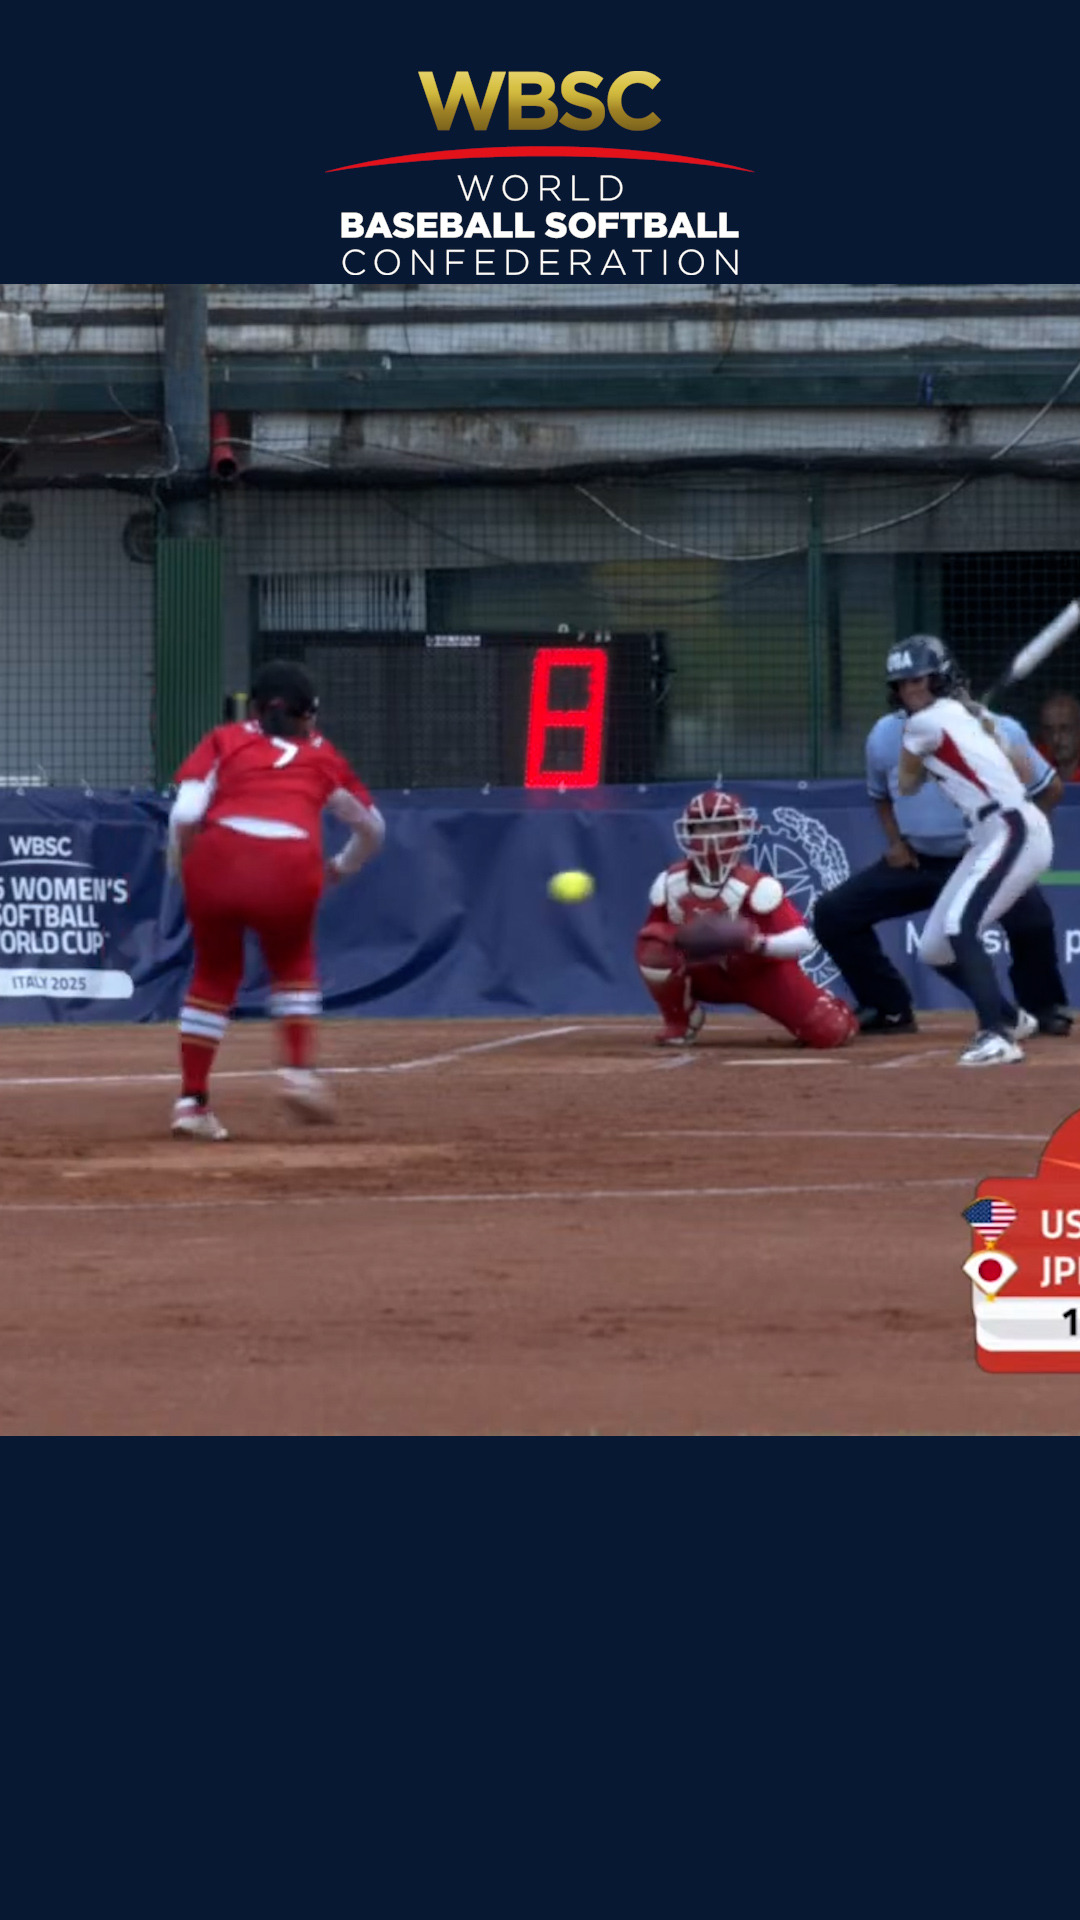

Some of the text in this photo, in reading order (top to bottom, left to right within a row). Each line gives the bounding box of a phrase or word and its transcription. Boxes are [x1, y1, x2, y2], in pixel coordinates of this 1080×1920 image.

[524, 647, 608, 788] 8
[270, 736, 299, 768] 7
[9, 835, 72, 857] WBSC
[10, 876, 129, 904] WOMEN'S
[0, 903, 99, 928] OFTBALL
[0, 929, 60, 954] ORLD
[12, 975, 87, 991] ITALY 2025
